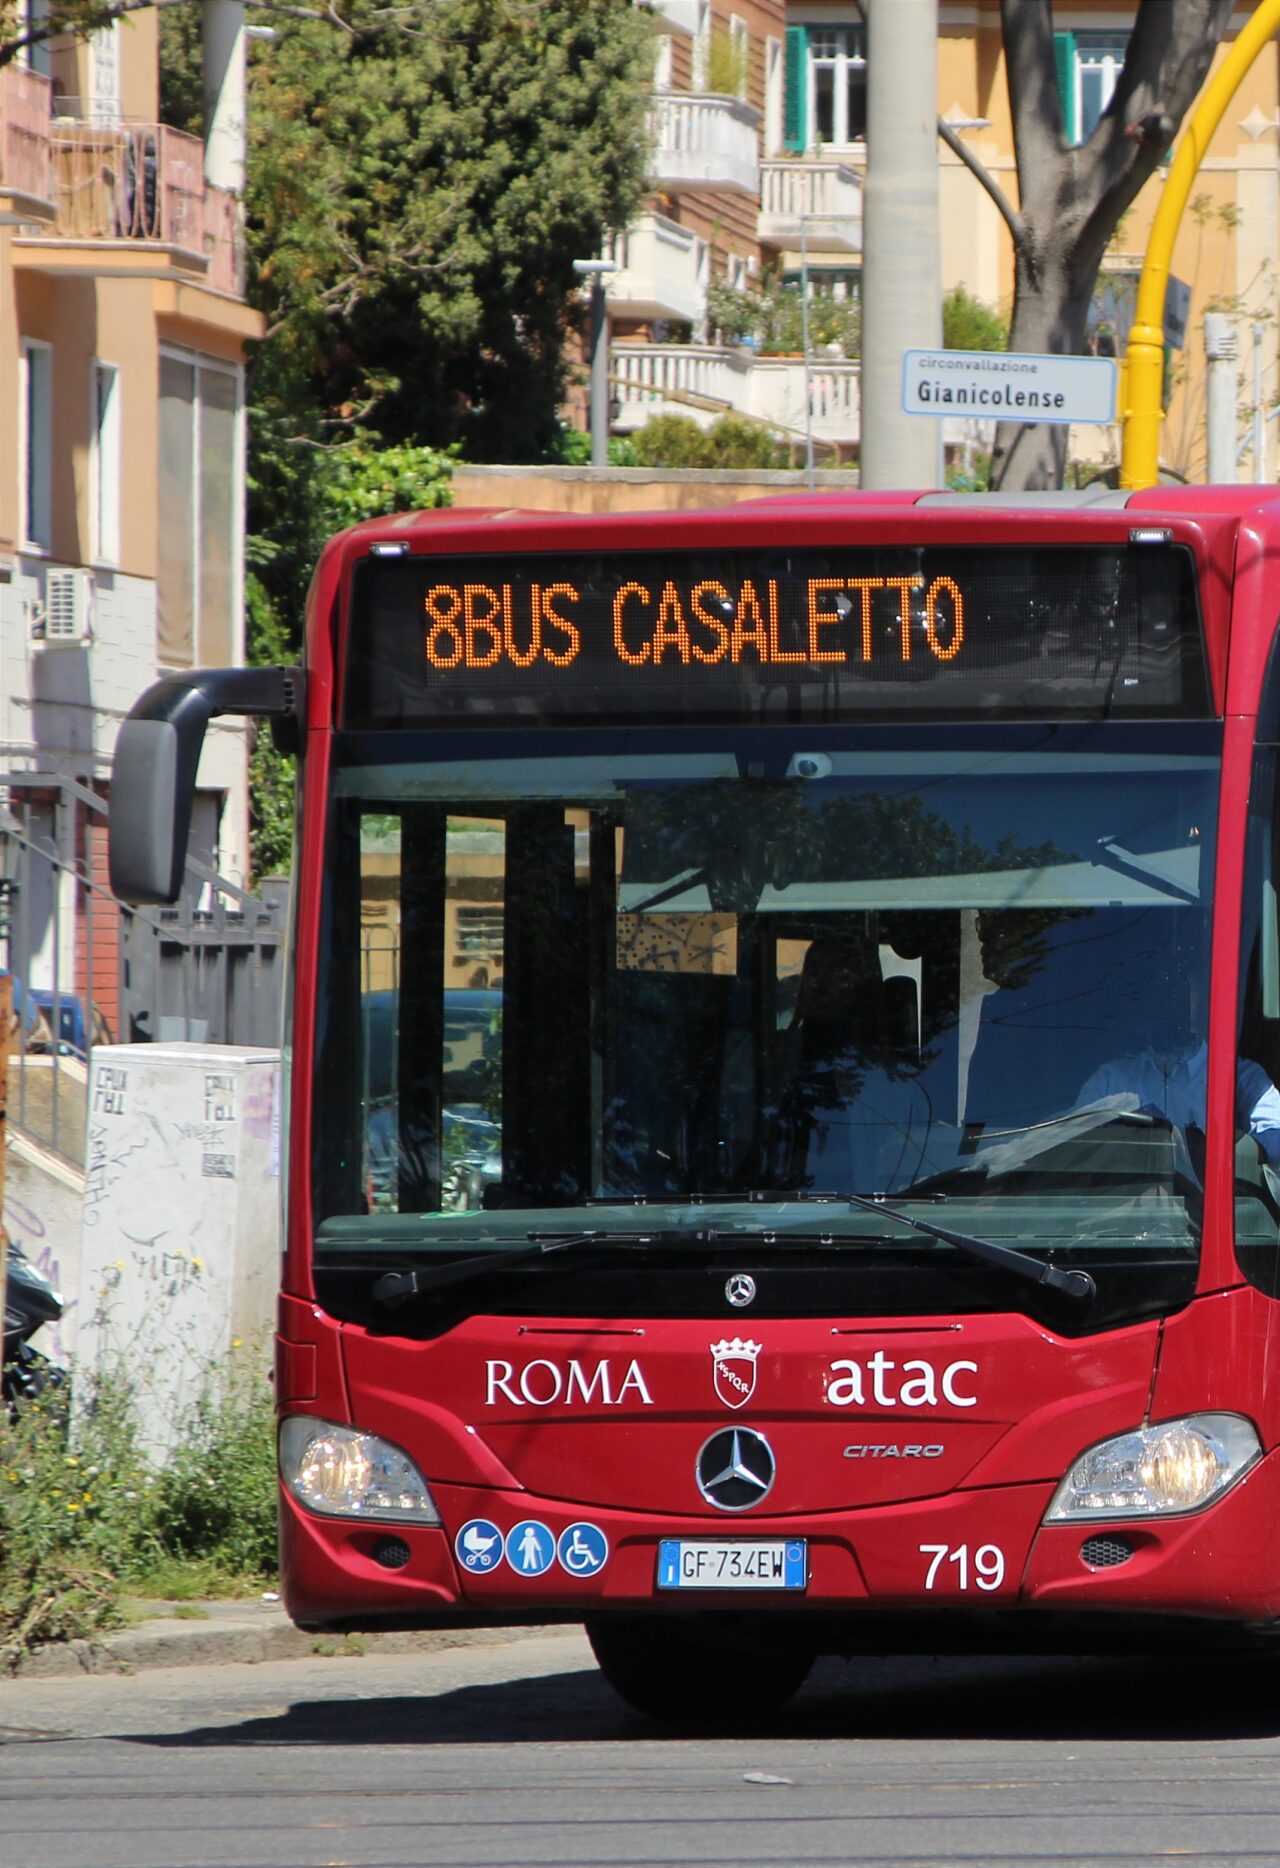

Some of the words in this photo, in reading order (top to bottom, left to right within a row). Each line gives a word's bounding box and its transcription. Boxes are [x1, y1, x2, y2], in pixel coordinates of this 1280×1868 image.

[919, 355, 1039, 374] circonvallazione
[917, 380, 1066, 409] Gianicolense
[424, 582, 581, 668] 8BUS
[611, 576, 966, 666] CASALETTO
[485, 1358, 654, 1406] ROMA
[826, 1350, 978, 1408] atac
[842, 1443, 945, 1459] CITARO
[919, 1543, 1006, 1592] 719
